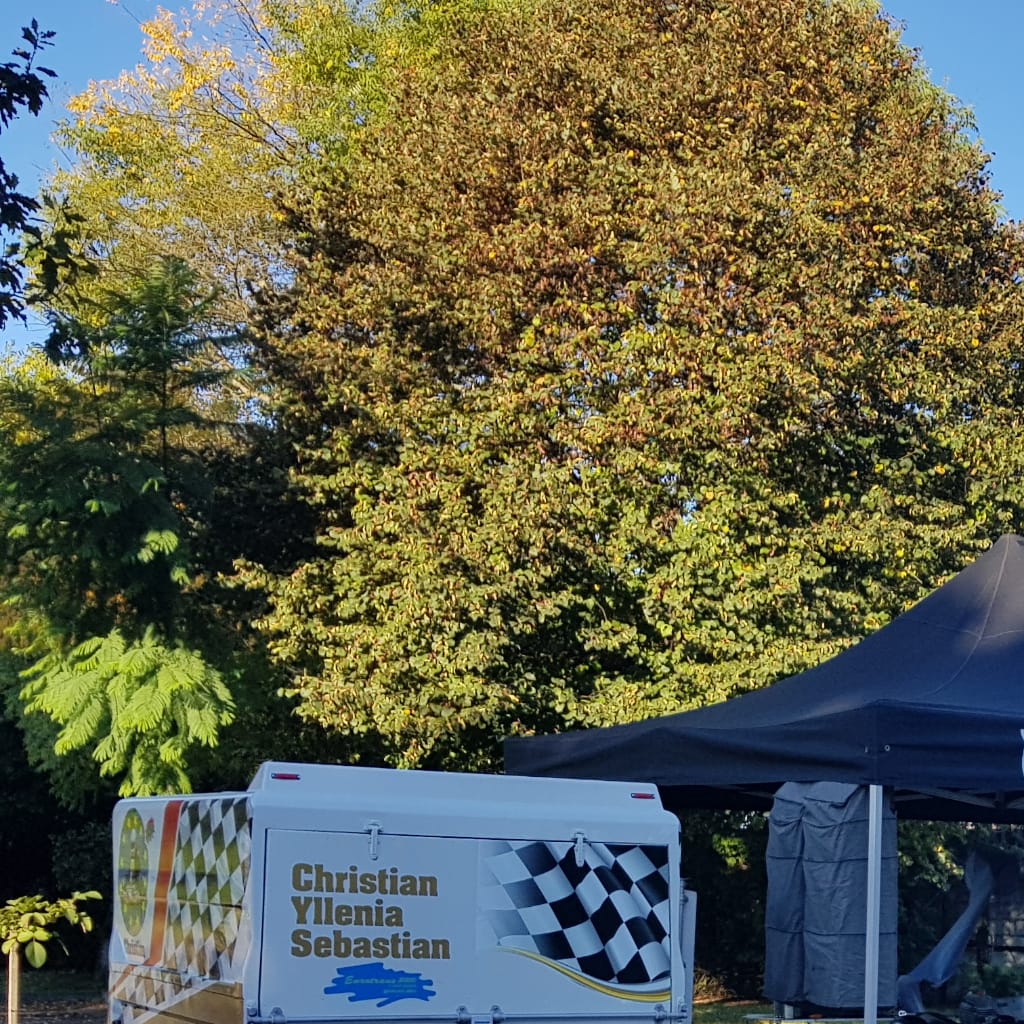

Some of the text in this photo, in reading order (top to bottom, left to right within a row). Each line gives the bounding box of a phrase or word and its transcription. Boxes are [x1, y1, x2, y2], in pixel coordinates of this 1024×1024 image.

[291, 862, 439, 897] Christian
[290, 896, 404, 928] Yllenia
[290, 928, 451, 960] Sebastian
